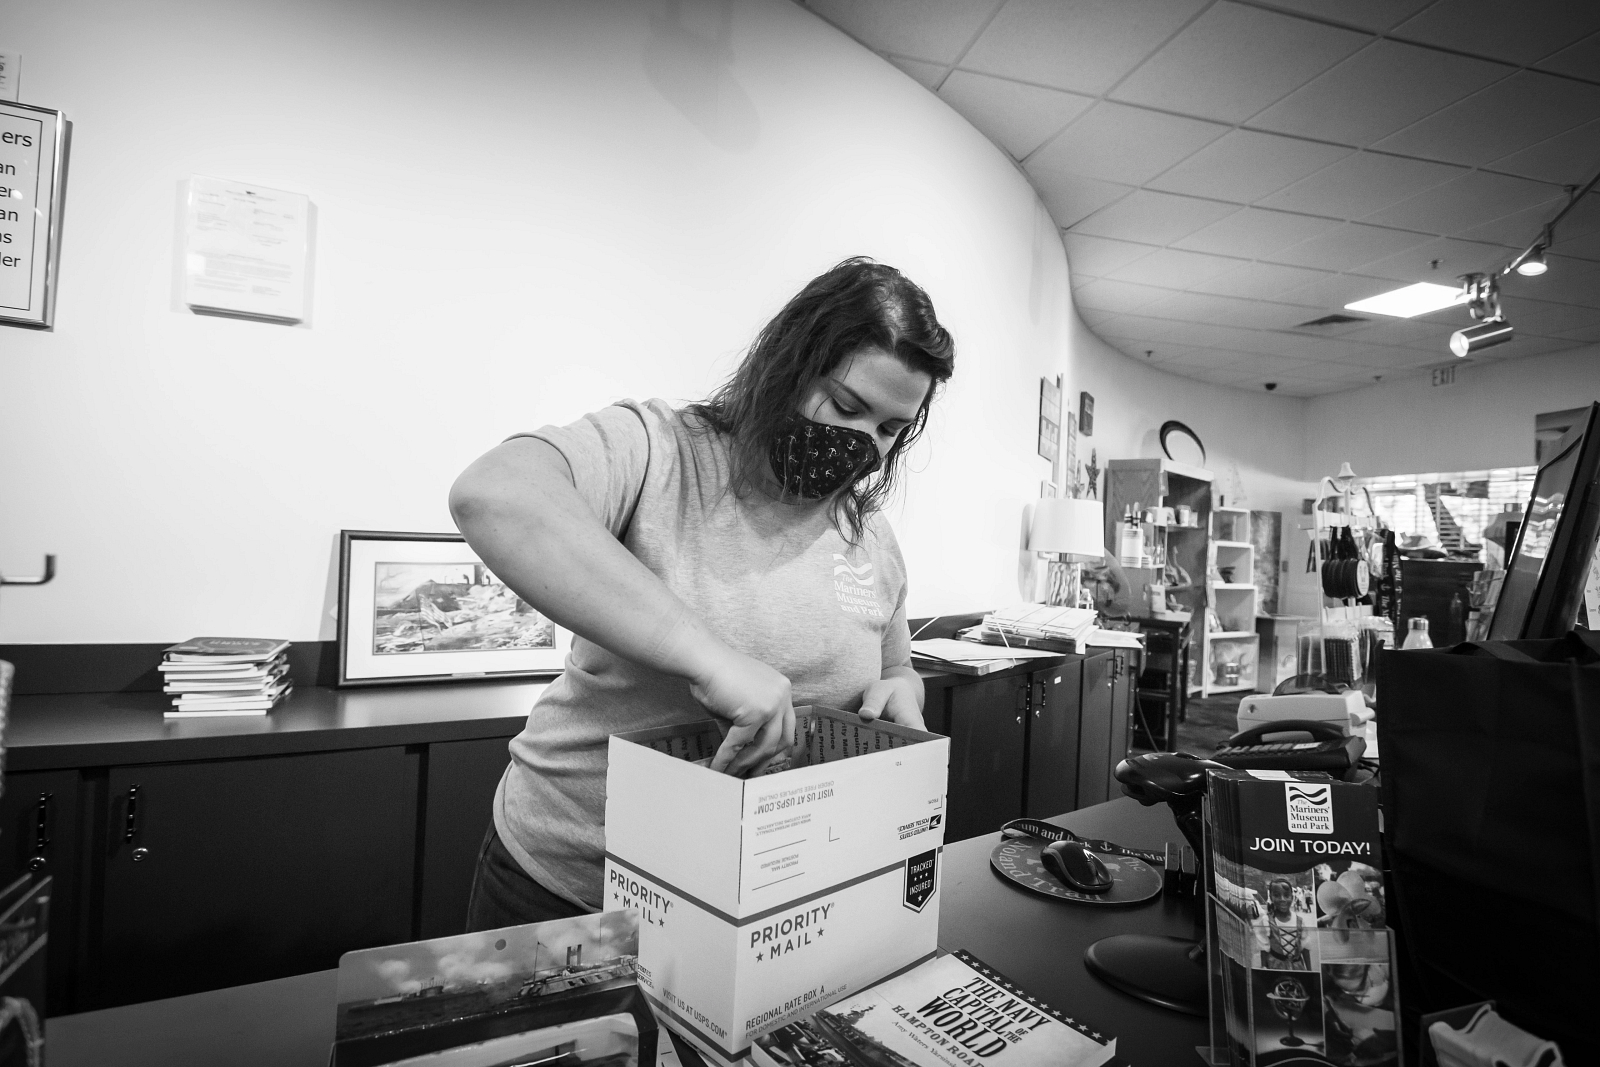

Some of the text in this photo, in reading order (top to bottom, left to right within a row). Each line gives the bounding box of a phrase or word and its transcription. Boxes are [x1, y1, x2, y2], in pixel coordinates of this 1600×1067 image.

[0, 251, 21, 268] er
[836, 592, 881, 608] Museum
[840, 604, 885, 618] and Park
[796, 796, 807, 805] AT
[806, 793, 816, 803] US
[817, 788, 834, 800] VISIT
[1290, 805, 1330, 814] Mariners'
[1290, 812, 1329, 822] Museum
[1291, 822, 1308, 830] and
[1040, 829, 1063, 841] and
[1249, 837, 1371, 855] JOIN TODAY!
[998, 840, 1033, 879] Noland
[770, 932, 812, 960] MAIL
[662, 987, 677, 1004] VISIT
[677, 998, 685, 1011] US
[685, 1005, 694, 1016] AT
[745, 985, 825, 1031] REGIONAL RATE BOX A
[962, 976, 1052, 1032] THE NAVY
[745, 983, 848, 1039] FOR DOMESTIC AND INTERNATIONAL USE
[942, 987, 1016, 1036] CAPITAL
[891, 1004, 951, 1047] HAMPTON
[916, 995, 1008, 1059] WORLD
[1014, 1027, 1029, 1036] OF
[1003, 1031, 1023, 1044] THE
